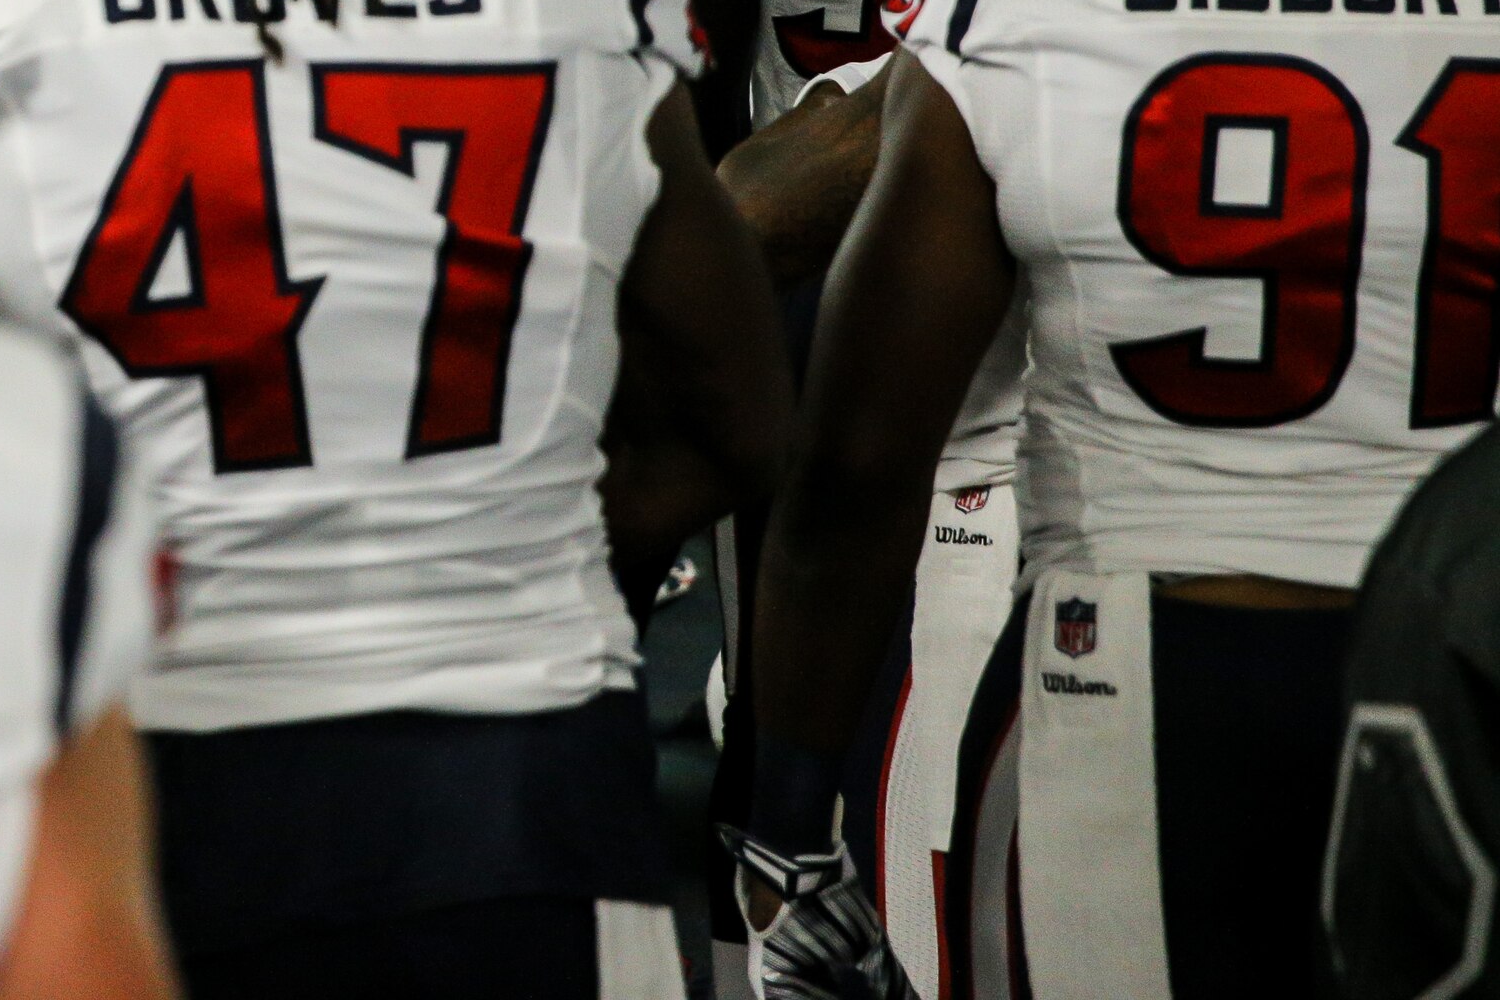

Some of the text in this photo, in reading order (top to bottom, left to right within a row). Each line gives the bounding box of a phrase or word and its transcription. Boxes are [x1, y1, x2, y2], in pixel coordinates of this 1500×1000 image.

[60, 57, 558, 474] 47
[1106, 50, 1500, 430] 91
[934, 526, 988, 546] Wilson
